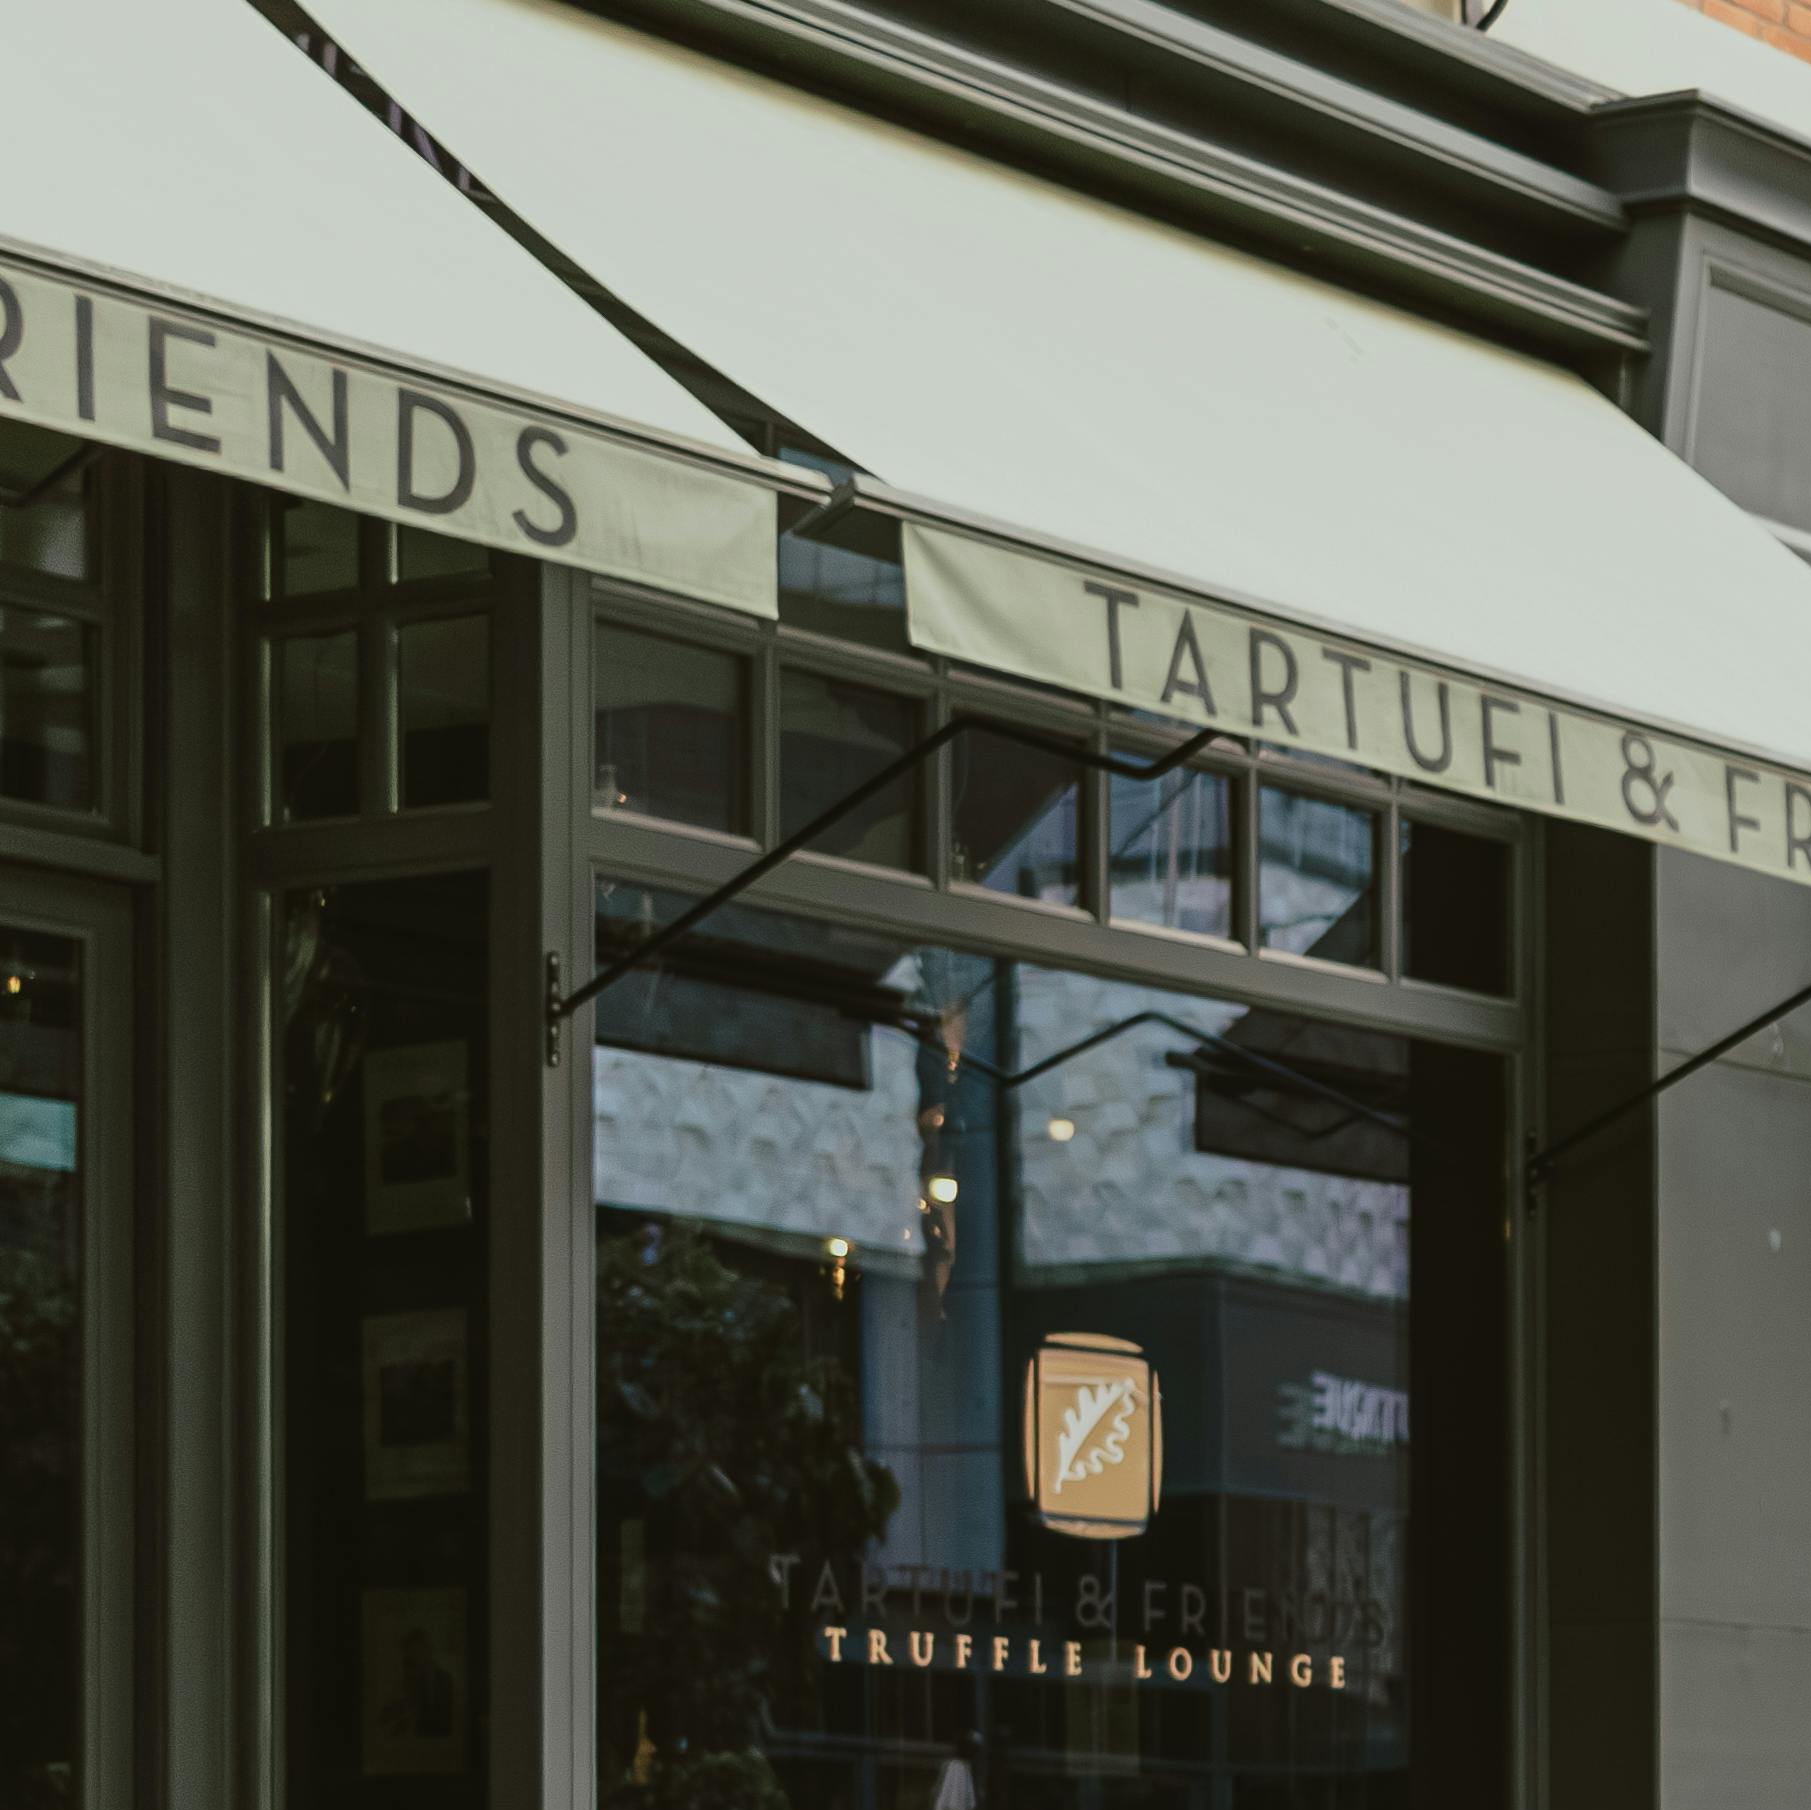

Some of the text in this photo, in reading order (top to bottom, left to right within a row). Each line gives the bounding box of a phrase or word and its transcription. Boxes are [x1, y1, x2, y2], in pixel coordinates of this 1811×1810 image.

[1083, 577, 1566, 806] TARTUFI
[1619, 730, 1681, 834] &
[823, 1624, 1347, 1690] TRUFFLE LOUNGE
